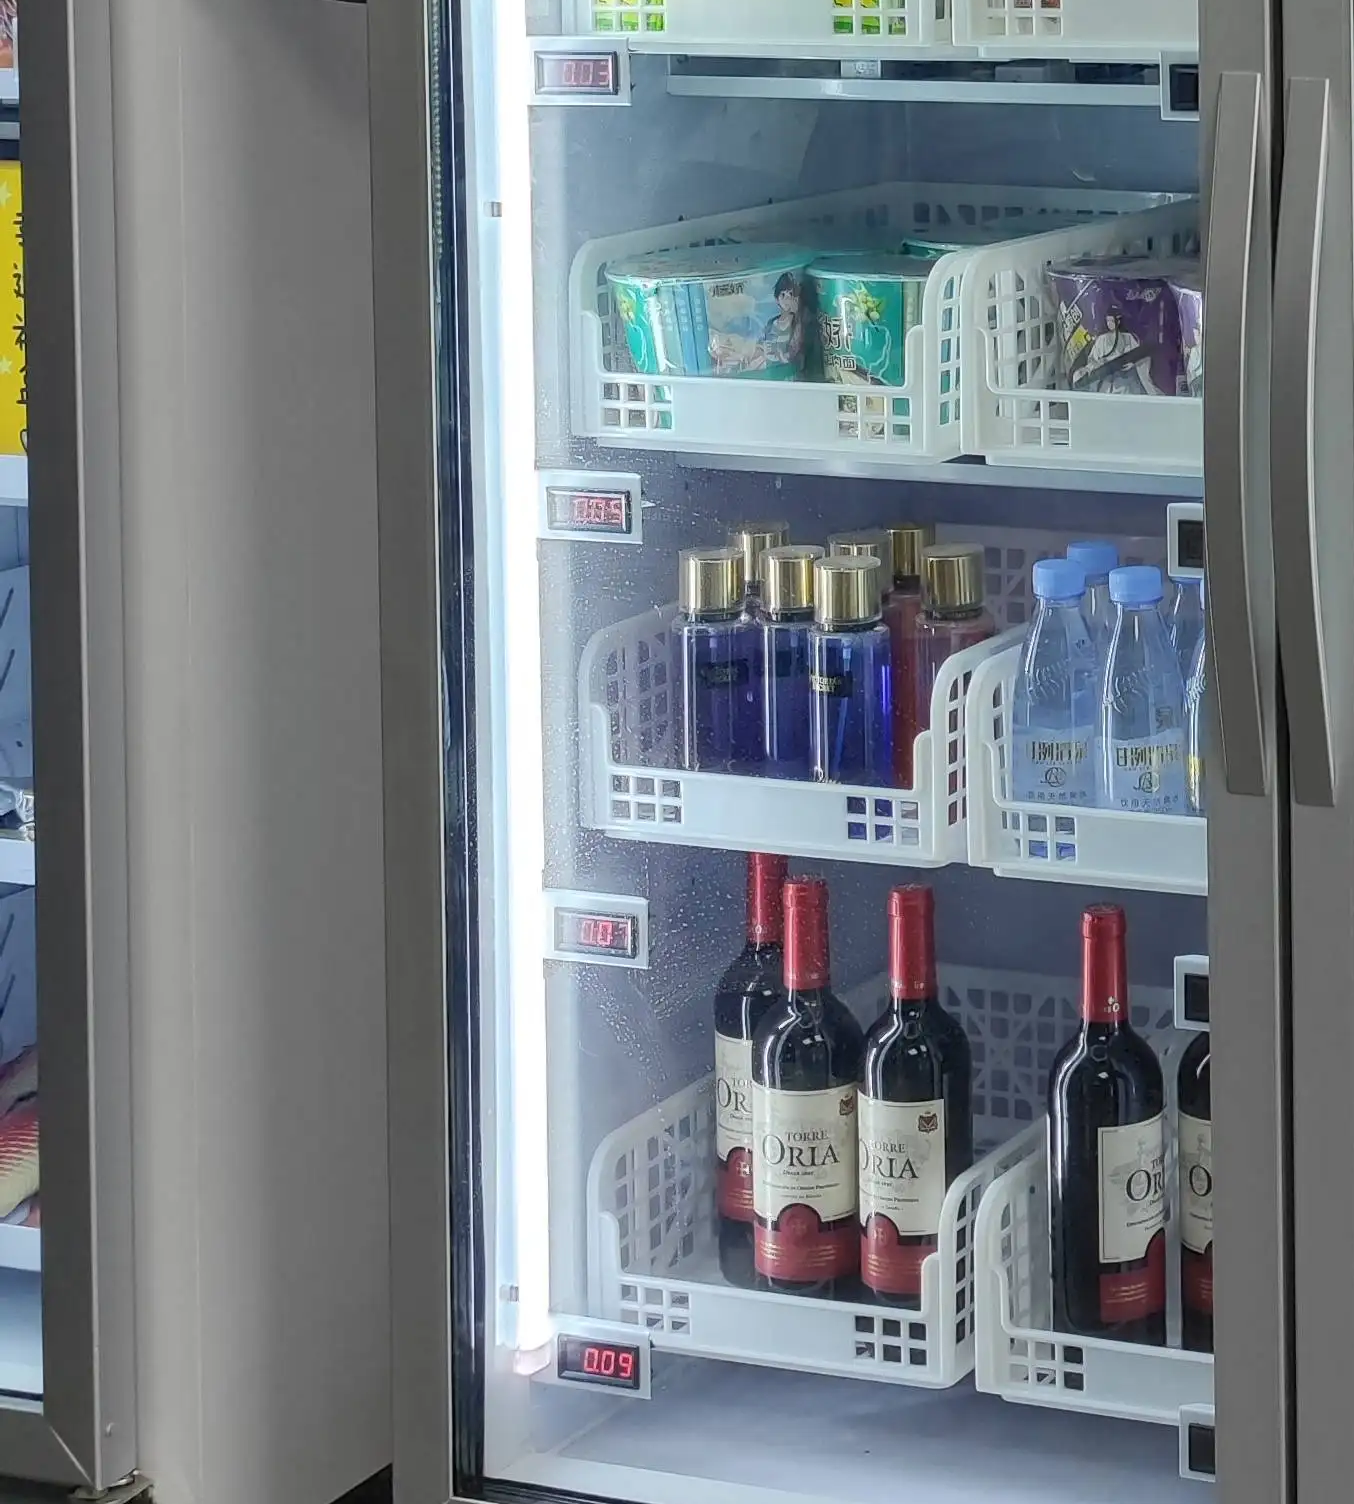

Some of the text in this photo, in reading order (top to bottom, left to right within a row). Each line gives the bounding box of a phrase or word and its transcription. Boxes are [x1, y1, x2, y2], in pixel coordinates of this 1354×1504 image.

[717, 1078, 752, 1113] OR
[763, 1134, 840, 1167] ORIA
[786, 1130, 830, 1142] TORRE
[584, 1347, 633, 1378] 0.09
